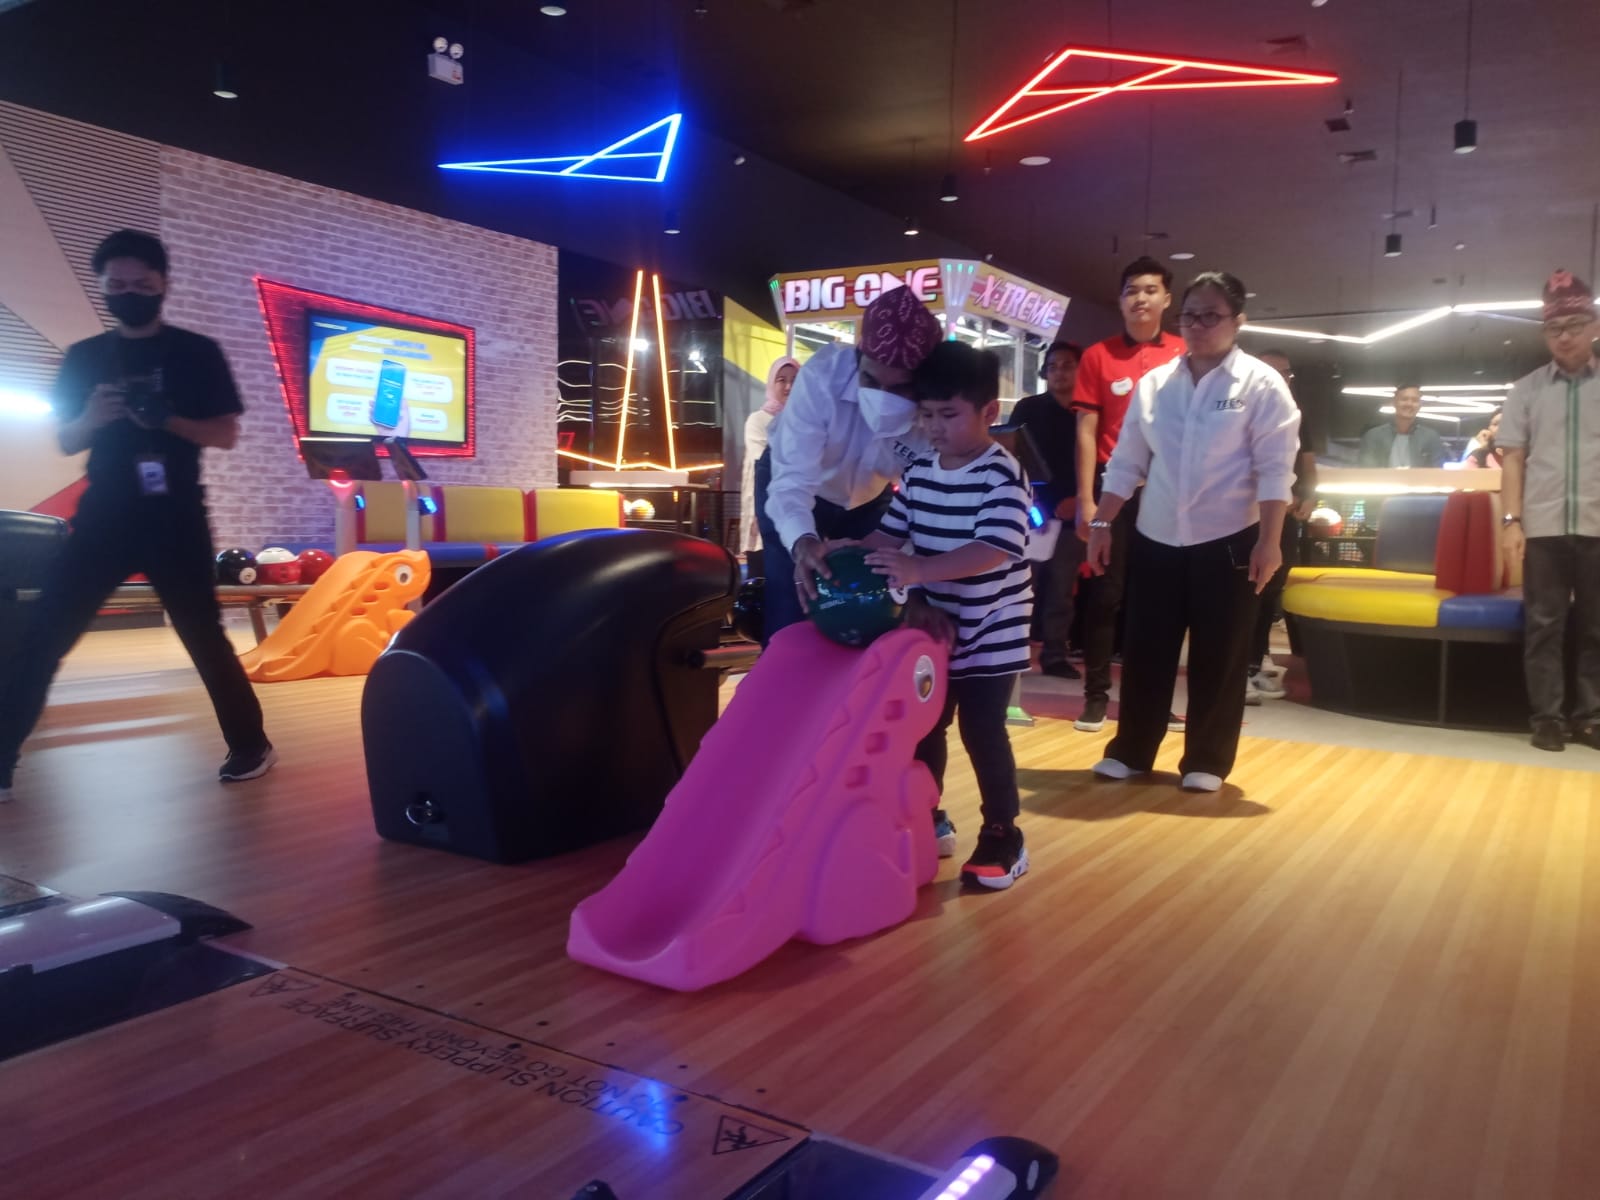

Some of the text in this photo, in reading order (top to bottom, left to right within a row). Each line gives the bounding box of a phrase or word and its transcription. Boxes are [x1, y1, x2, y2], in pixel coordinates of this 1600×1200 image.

[784, 275, 845, 313] BIG
[424, 1030, 527, 1065] BEYOND
[280, 999, 685, 1136] CAUTION SLIPPERY SURFACE
[526, 1060, 568, 1079] GO
[566, 1075, 629, 1099] NOT
